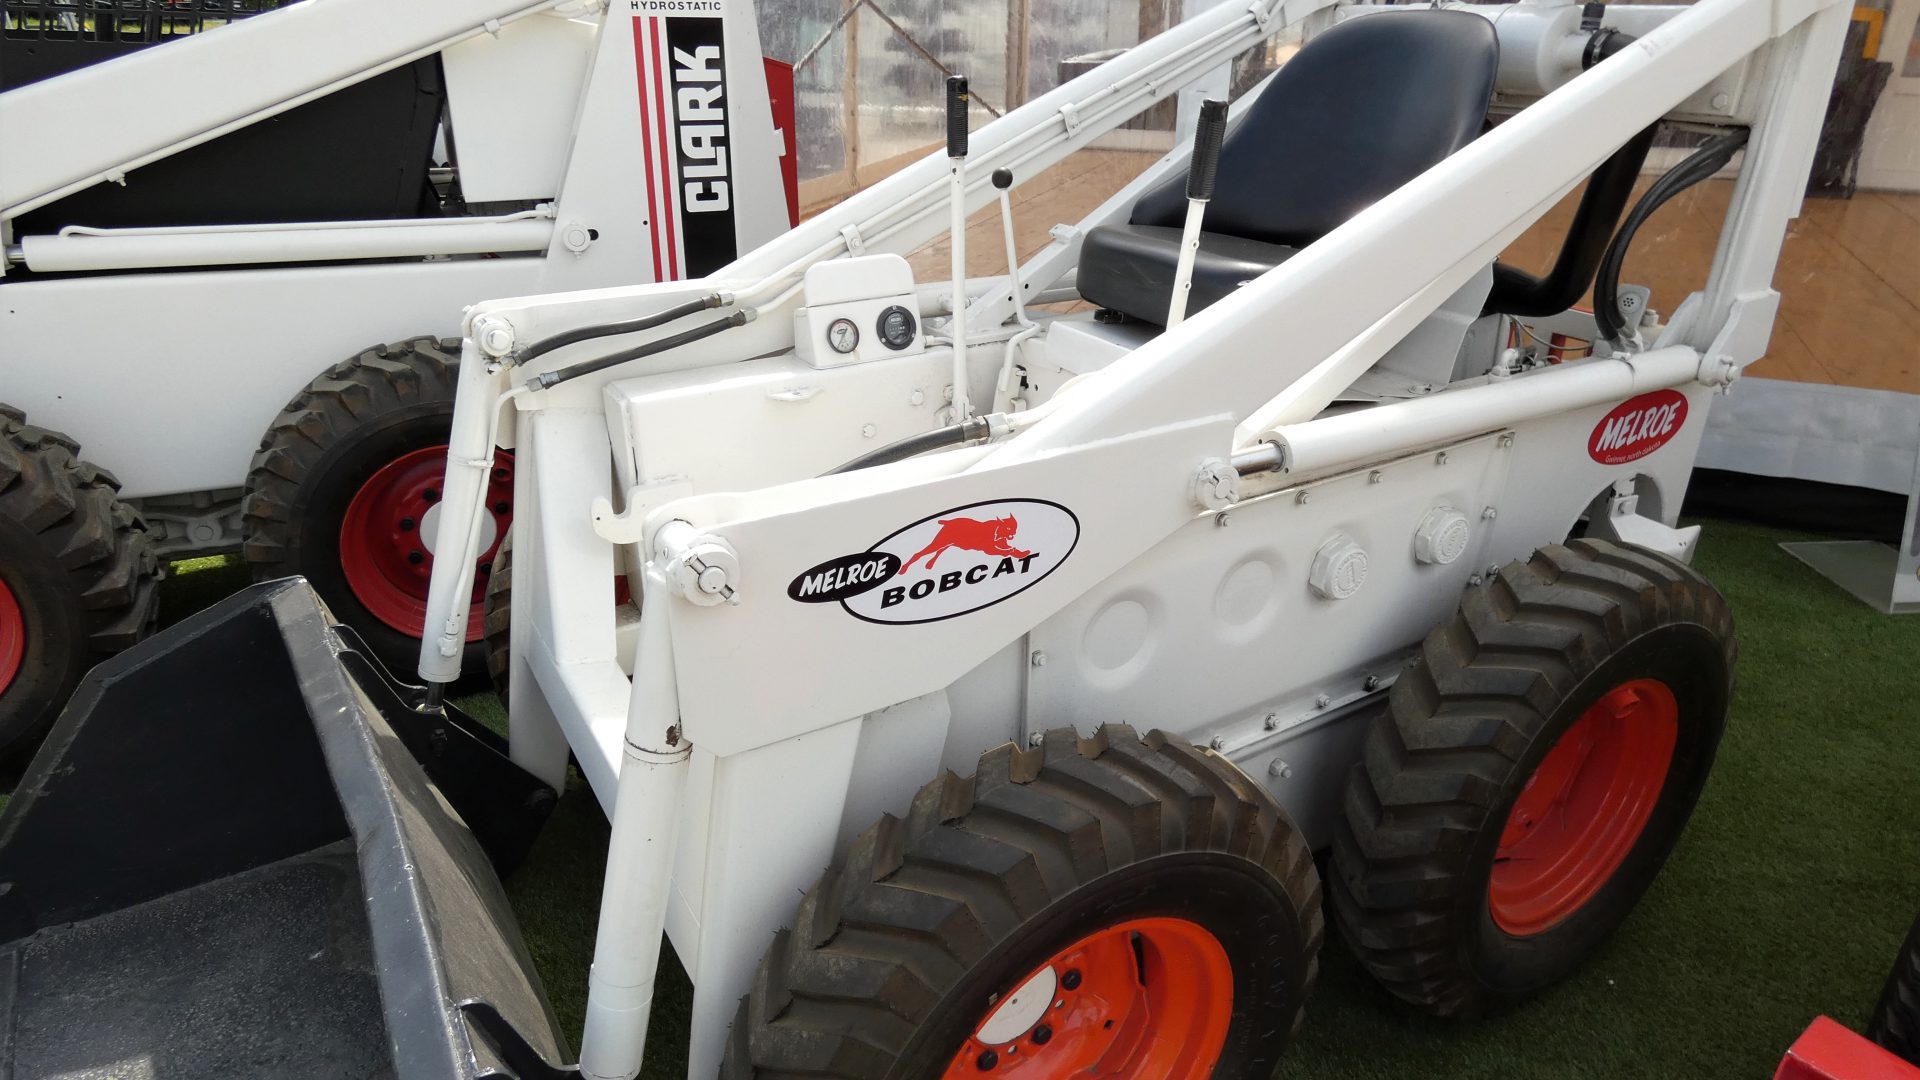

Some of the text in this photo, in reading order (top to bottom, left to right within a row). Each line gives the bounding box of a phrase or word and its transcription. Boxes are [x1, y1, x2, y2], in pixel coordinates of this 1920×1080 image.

[631, 1, 721, 10] HYDROSTATIC
[674, 45, 729, 213] CLARK
[1595, 400, 1682, 452] MELROE
[799, 557, 890, 597] MELROE
[880, 552, 1040, 609] BOBCAT
